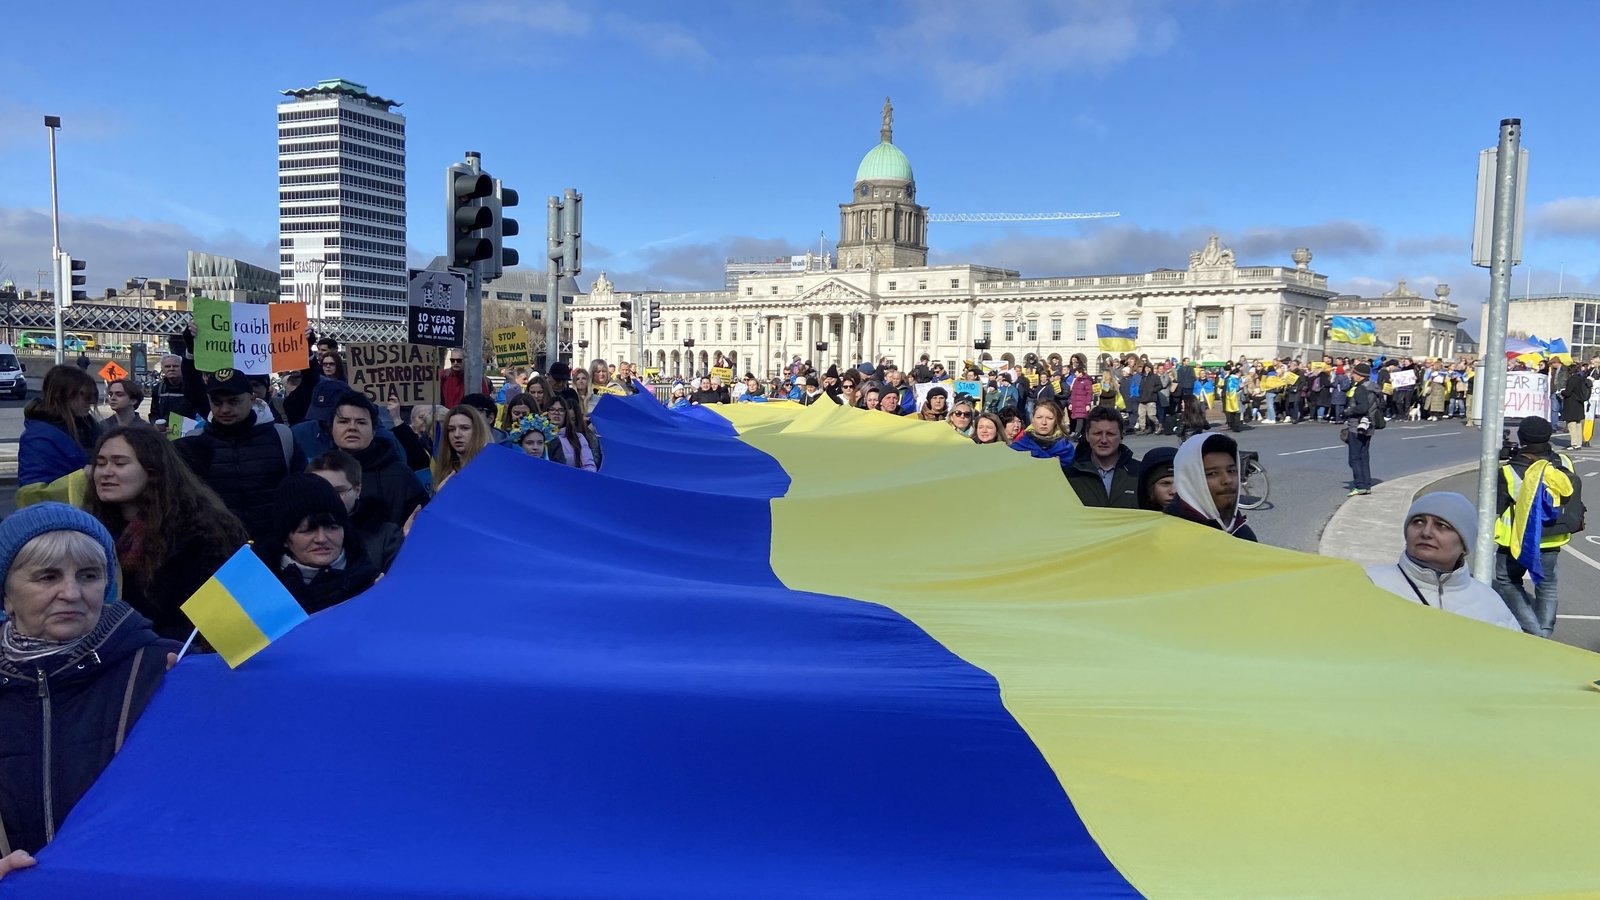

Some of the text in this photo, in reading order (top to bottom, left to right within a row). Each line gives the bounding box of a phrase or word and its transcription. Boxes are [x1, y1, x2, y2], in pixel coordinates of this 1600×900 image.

[296, 283, 323, 305] NOW
[211, 314, 230, 331] Go
[234, 318, 269, 334] raibh
[418, 313, 456, 325] 10 YEARS
[418, 323, 455, 335] OF WAR
[498, 331, 516, 341] STOP
[206, 334, 304, 363] maith agaibh!
[495, 342, 526, 353] THE WAR
[351, 344, 423, 367] RUSSIA
[353, 369, 366, 384] A
[1506, 373, 1530, 389] EAR
[364, 382, 425, 402] STATE
[958, 382, 975, 390] STAND
